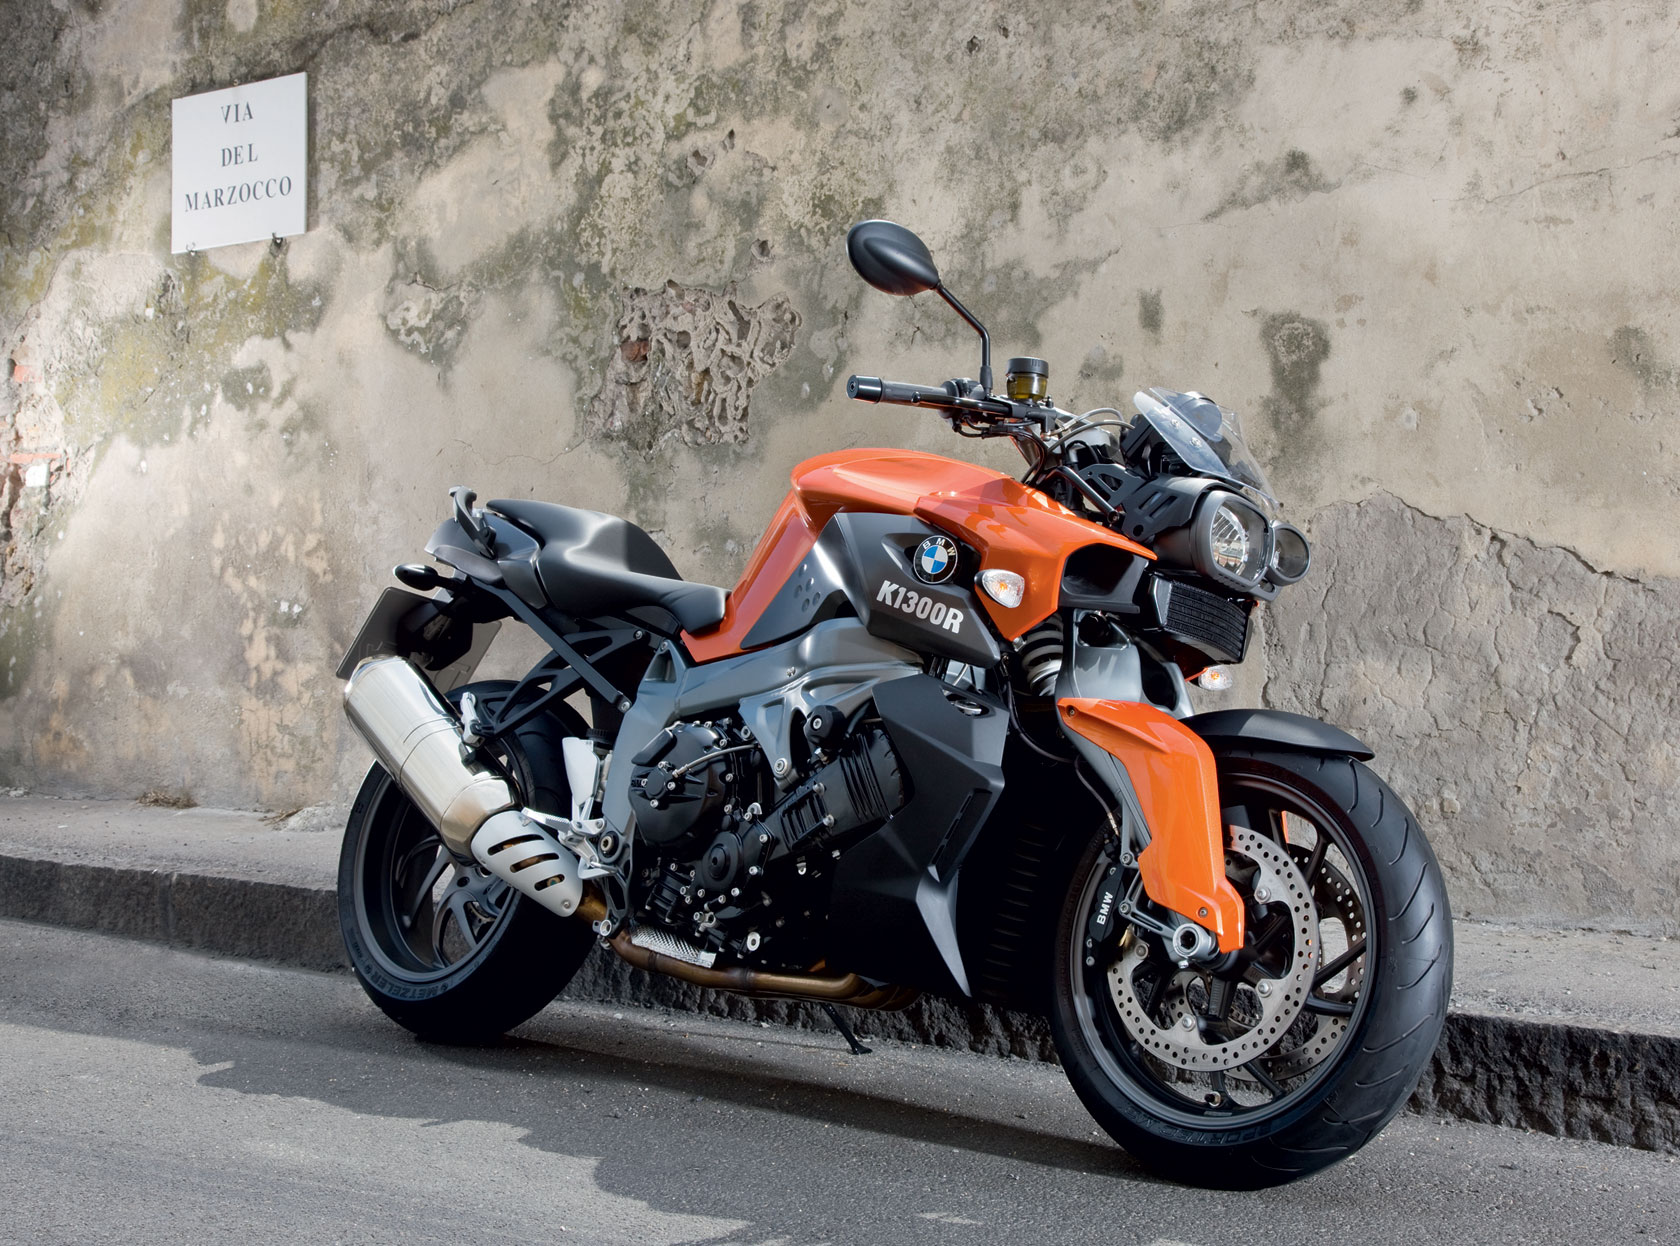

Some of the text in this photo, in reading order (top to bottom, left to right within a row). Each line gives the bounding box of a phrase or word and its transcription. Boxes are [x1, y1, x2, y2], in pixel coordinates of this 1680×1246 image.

[221, 101, 254, 124] VIA
[221, 143, 258, 168] DEL
[185, 175, 292, 212] MARZOCCO
[922, 537, 956, 557] BMW
[876, 579, 964, 634] K1300R
[1096, 891, 1114, 925] BMW
[370, 971, 439, 999] METZELER
